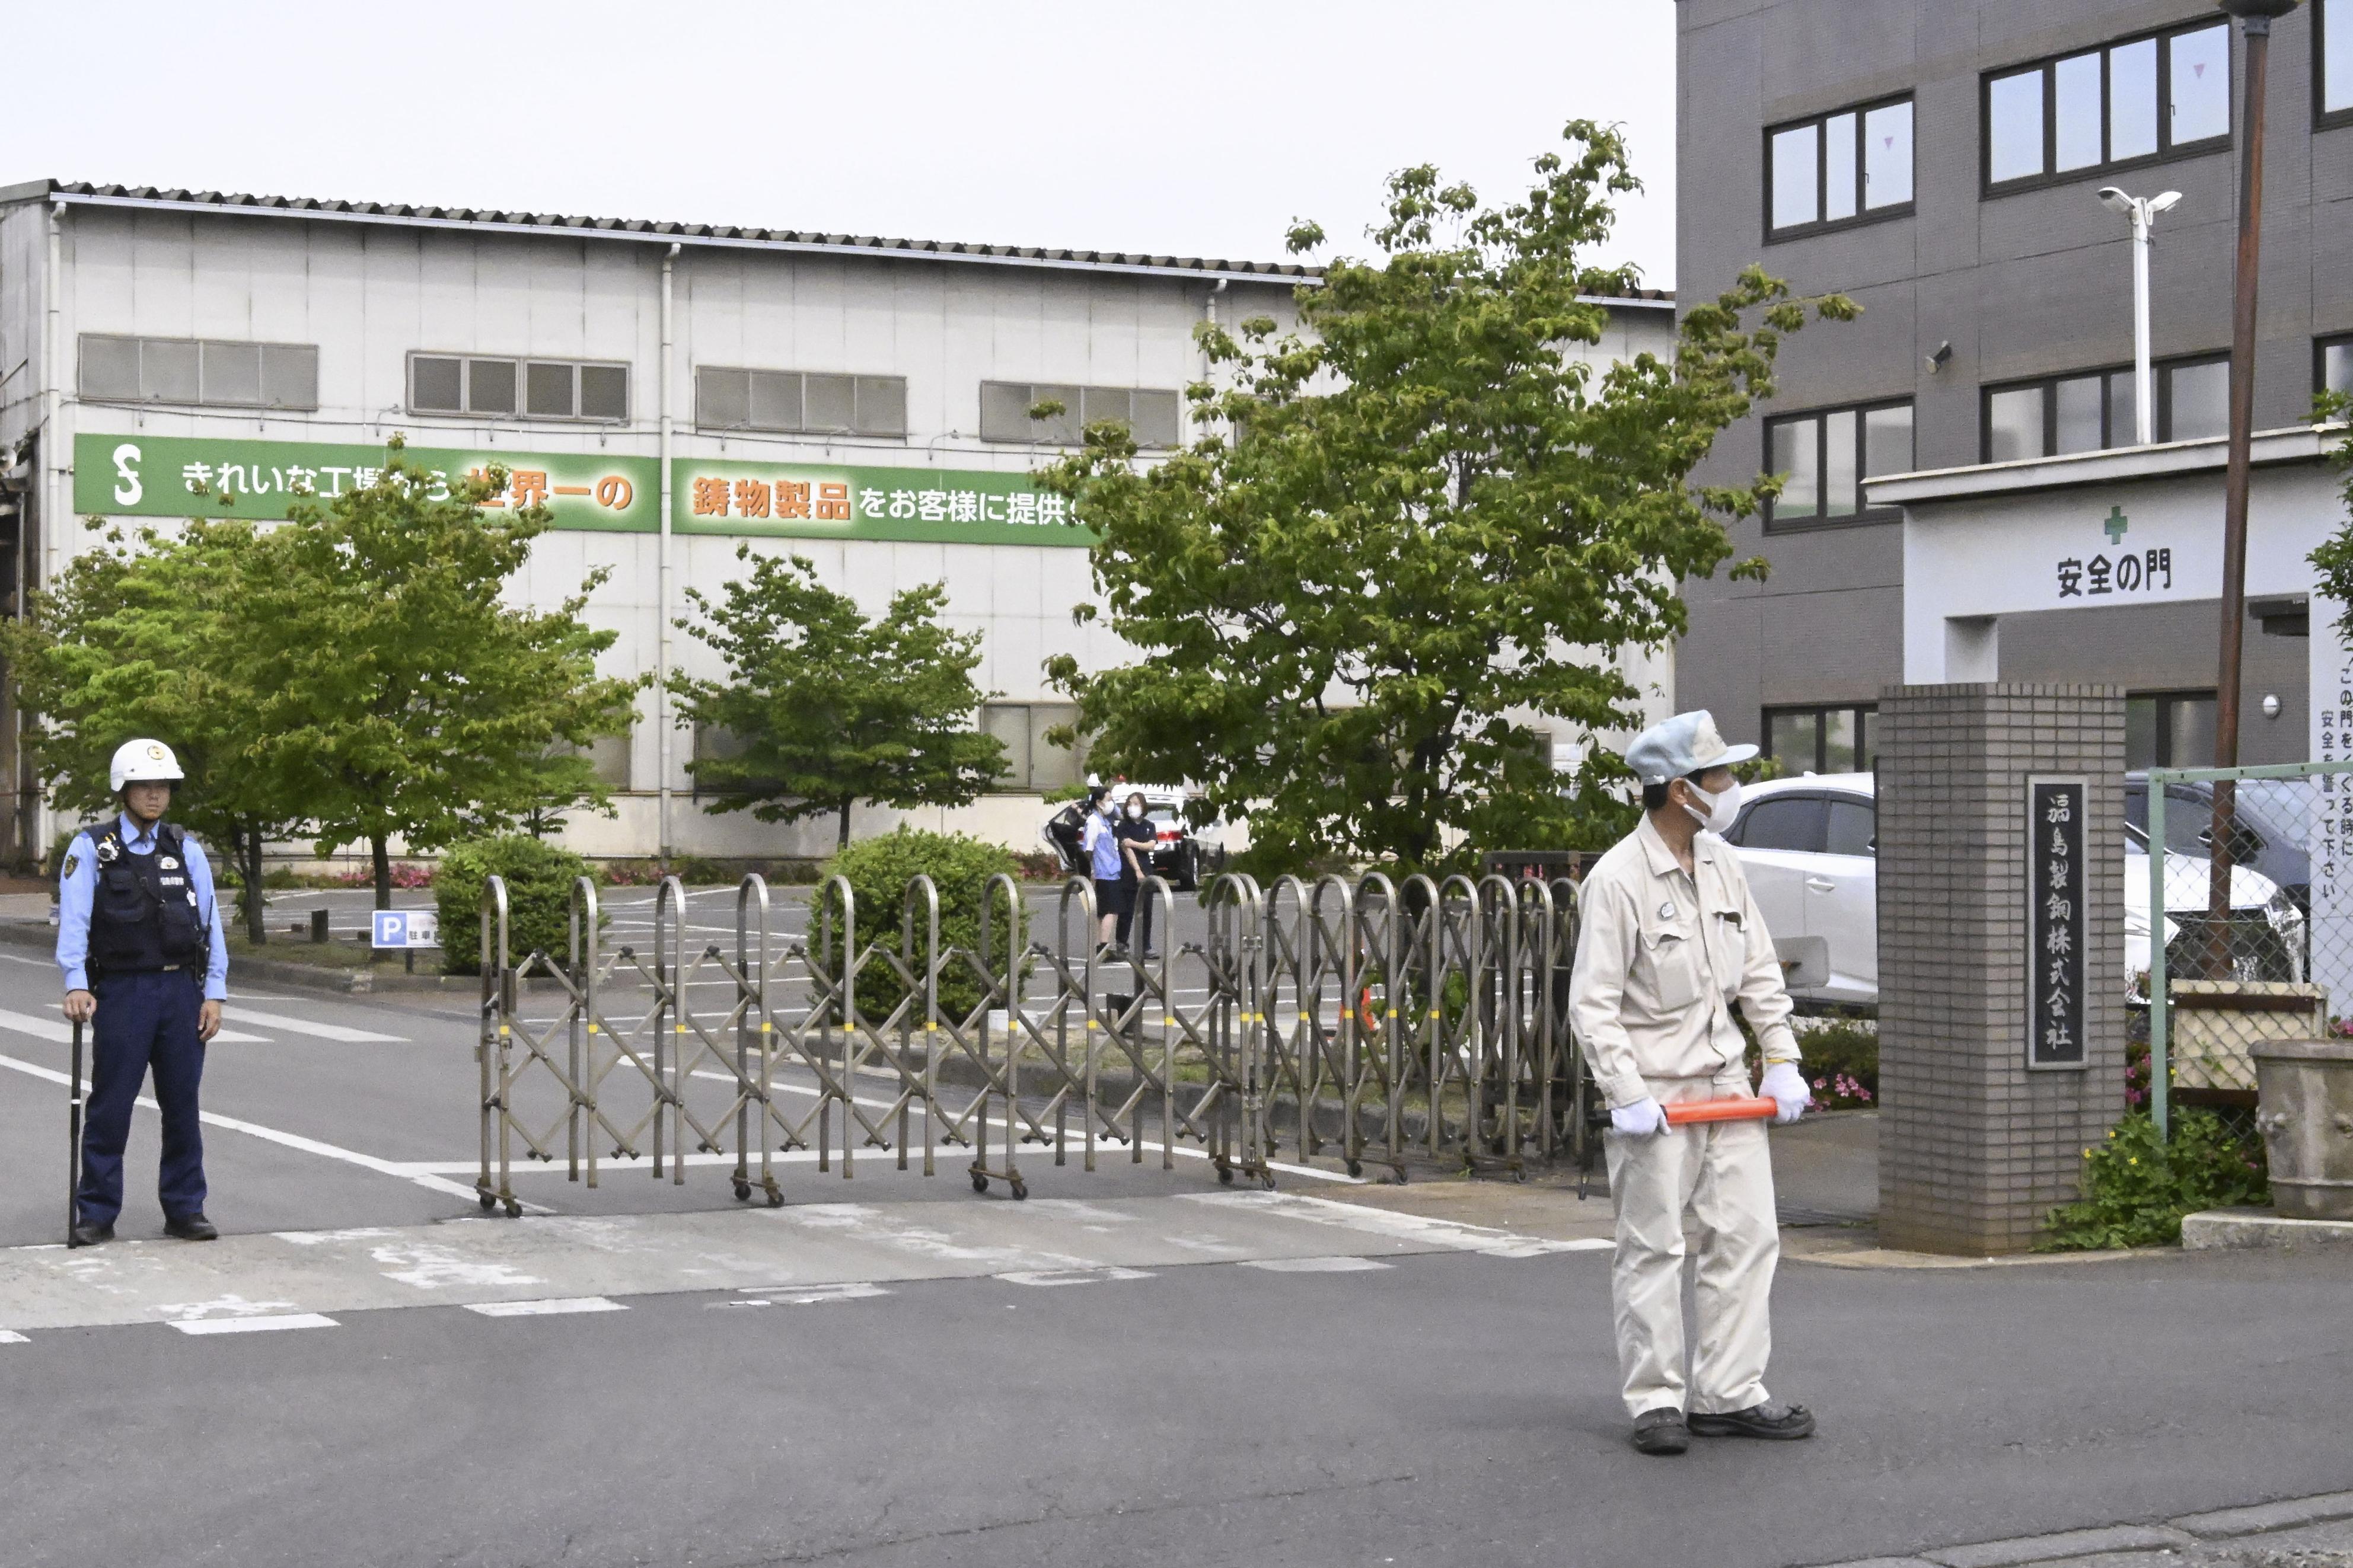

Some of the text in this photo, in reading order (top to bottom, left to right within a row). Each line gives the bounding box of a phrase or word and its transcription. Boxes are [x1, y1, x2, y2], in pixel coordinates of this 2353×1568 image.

[859, 487, 1086, 525] をお客様に提供
[2058, 548, 2171, 598] 安全の門
[383, 917, 401, 941] P
